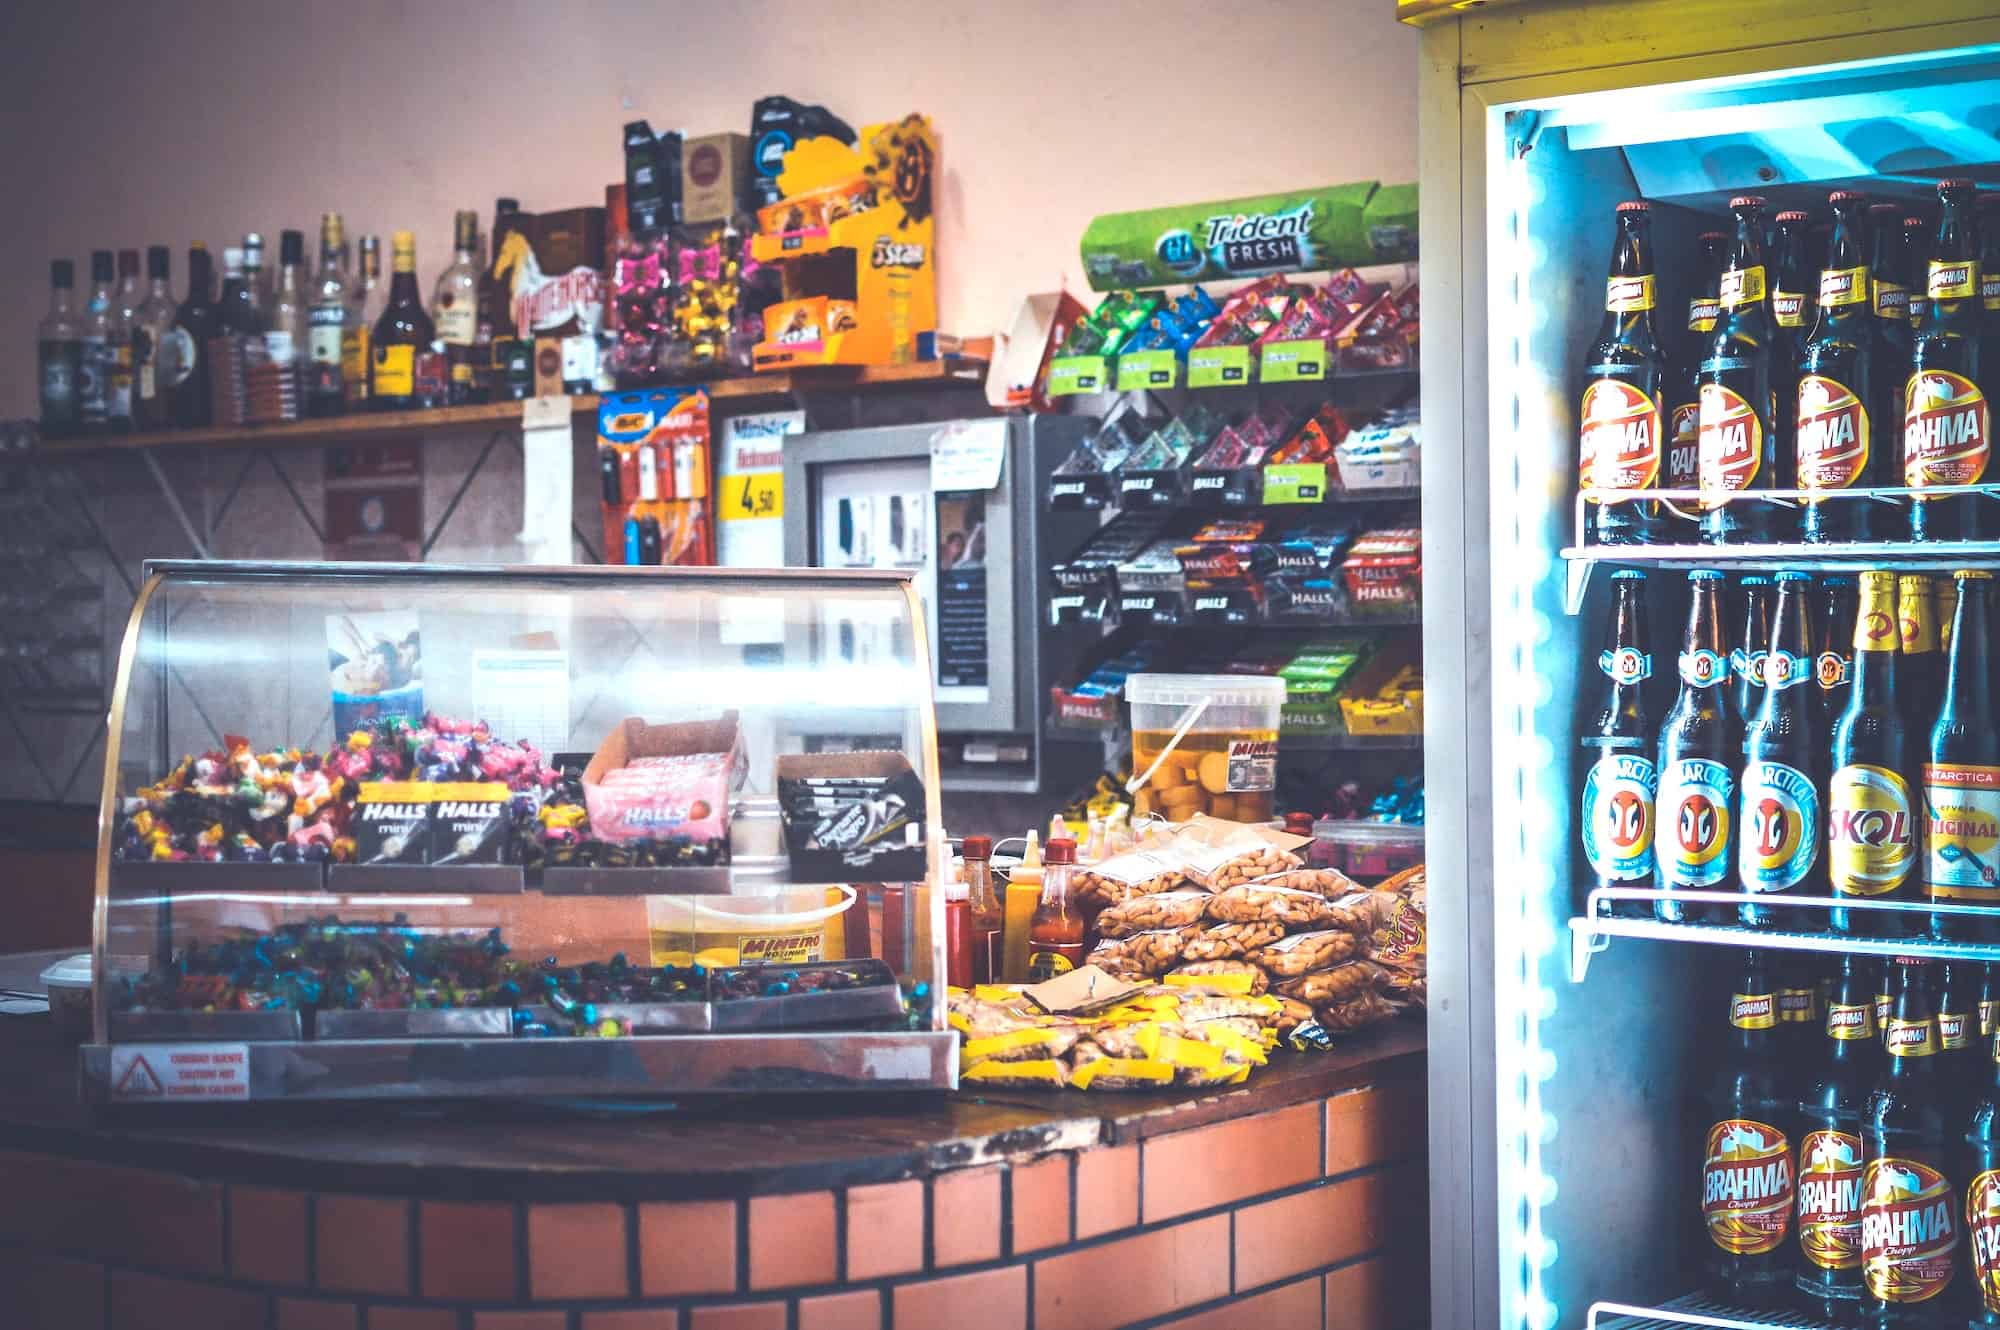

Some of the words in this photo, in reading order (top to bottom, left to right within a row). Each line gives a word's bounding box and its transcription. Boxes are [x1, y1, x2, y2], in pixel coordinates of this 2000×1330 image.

[1207, 207, 1312, 247] Trident
[1230, 241, 1296, 262] FRESH
[1277, 555, 1315, 567] HALLS
[1292, 592, 1334, 604] HALLS
[1357, 586, 1404, 600] HALLS
[1281, 713, 1326, 725] HALLS
[363, 802, 427, 820] HALLS
[437, 800, 501, 818] HALLS
[625, 808, 688, 822] HALLS
[378, 823, 410, 834] mini
[453, 821, 484, 832] mini
[1829, 808, 1912, 848] SKOL
[743, 935, 820, 954] MINEIRO
[1736, 1000, 1769, 1017] BRAHMA
[1706, 1158, 1790, 1204] BRAHMA
[1800, 1177, 1862, 1216] BRAHM
[1727, 1200, 1760, 1209] Chopp
[1817, 1213, 1847, 1222] Chopp
[1862, 1200, 1952, 1254] BRAHMA
[1883, 1246, 1916, 1256] Chopp
